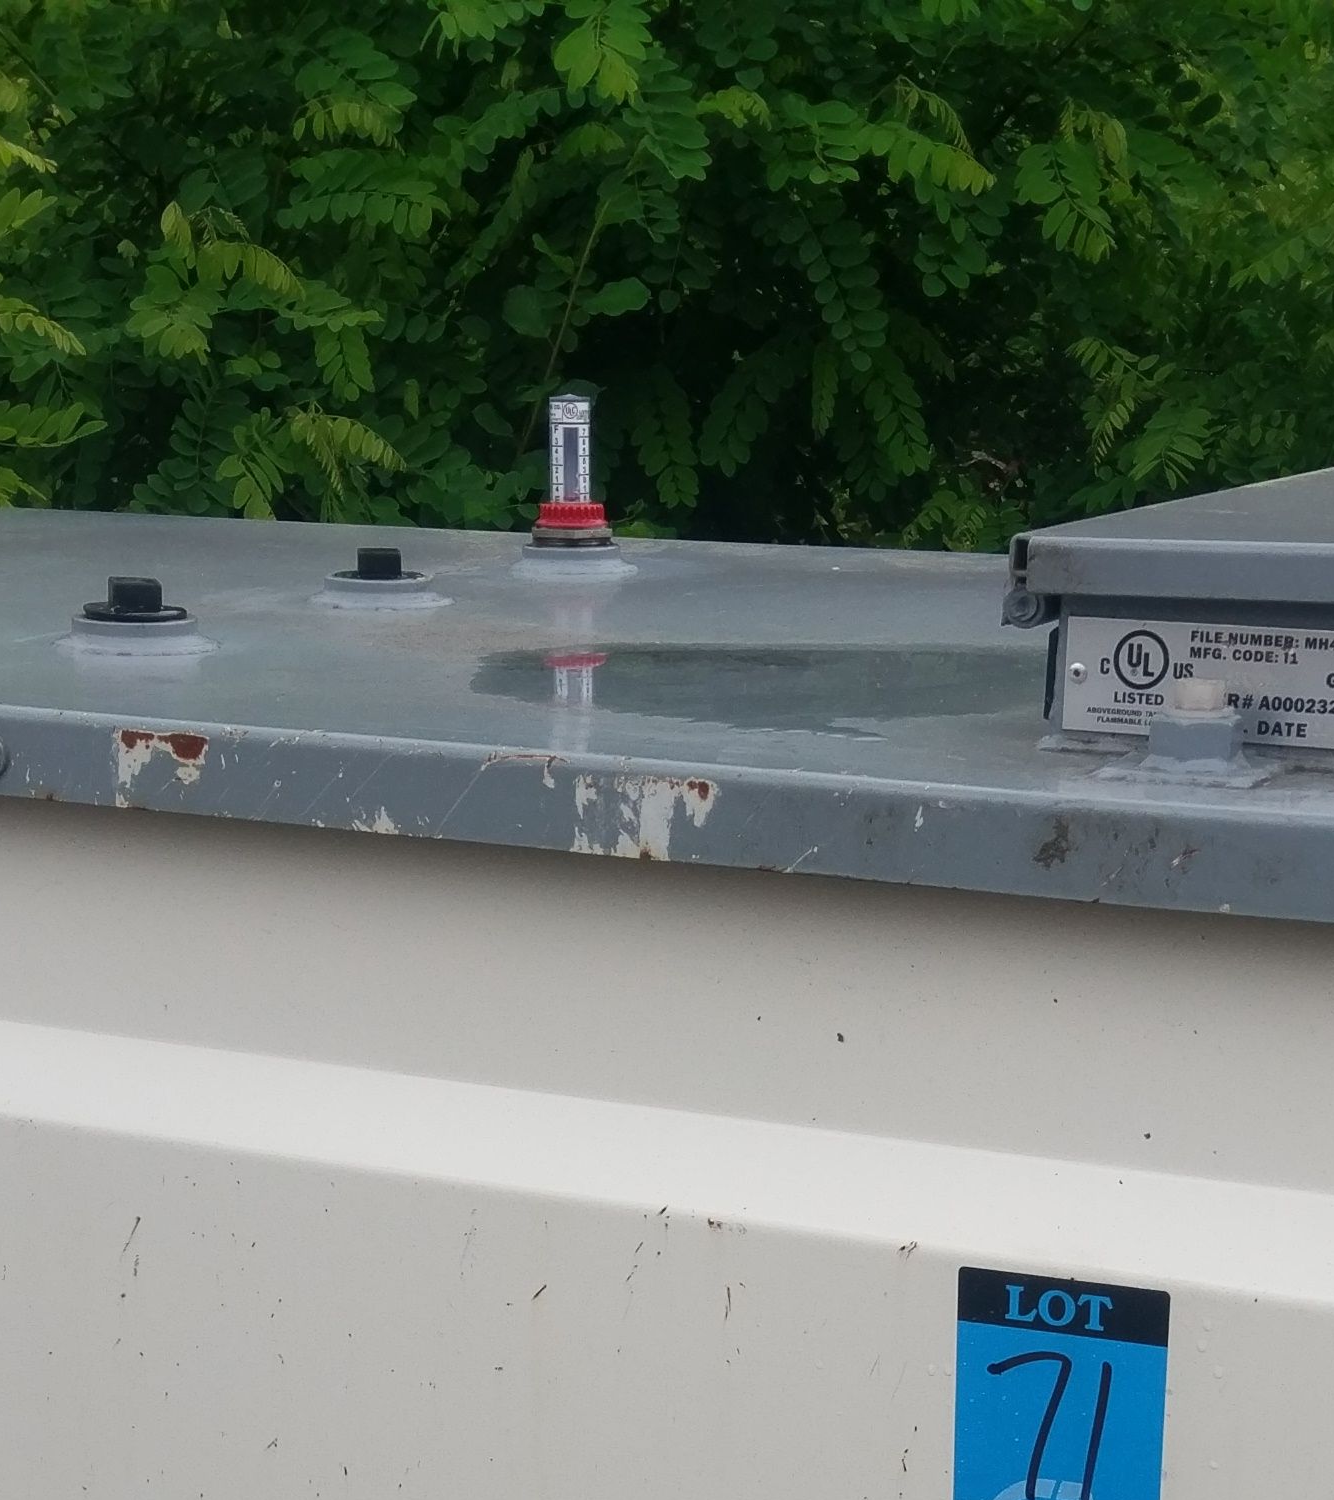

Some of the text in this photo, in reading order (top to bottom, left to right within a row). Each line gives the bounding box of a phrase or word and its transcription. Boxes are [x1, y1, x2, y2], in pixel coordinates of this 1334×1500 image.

[1190, 630, 1224, 644] FILE
[1228, 632, 1300, 649] NUMBER:
[1099, 643, 1195, 680] C UL US
[1189, 646, 1227, 660] MFG.
[1232, 648, 1279, 664] CODE:
[1113, 691, 1165, 706] LISTED
[1257, 720, 1308, 738] DATE
[1004, 1284, 1114, 1332] LOT
